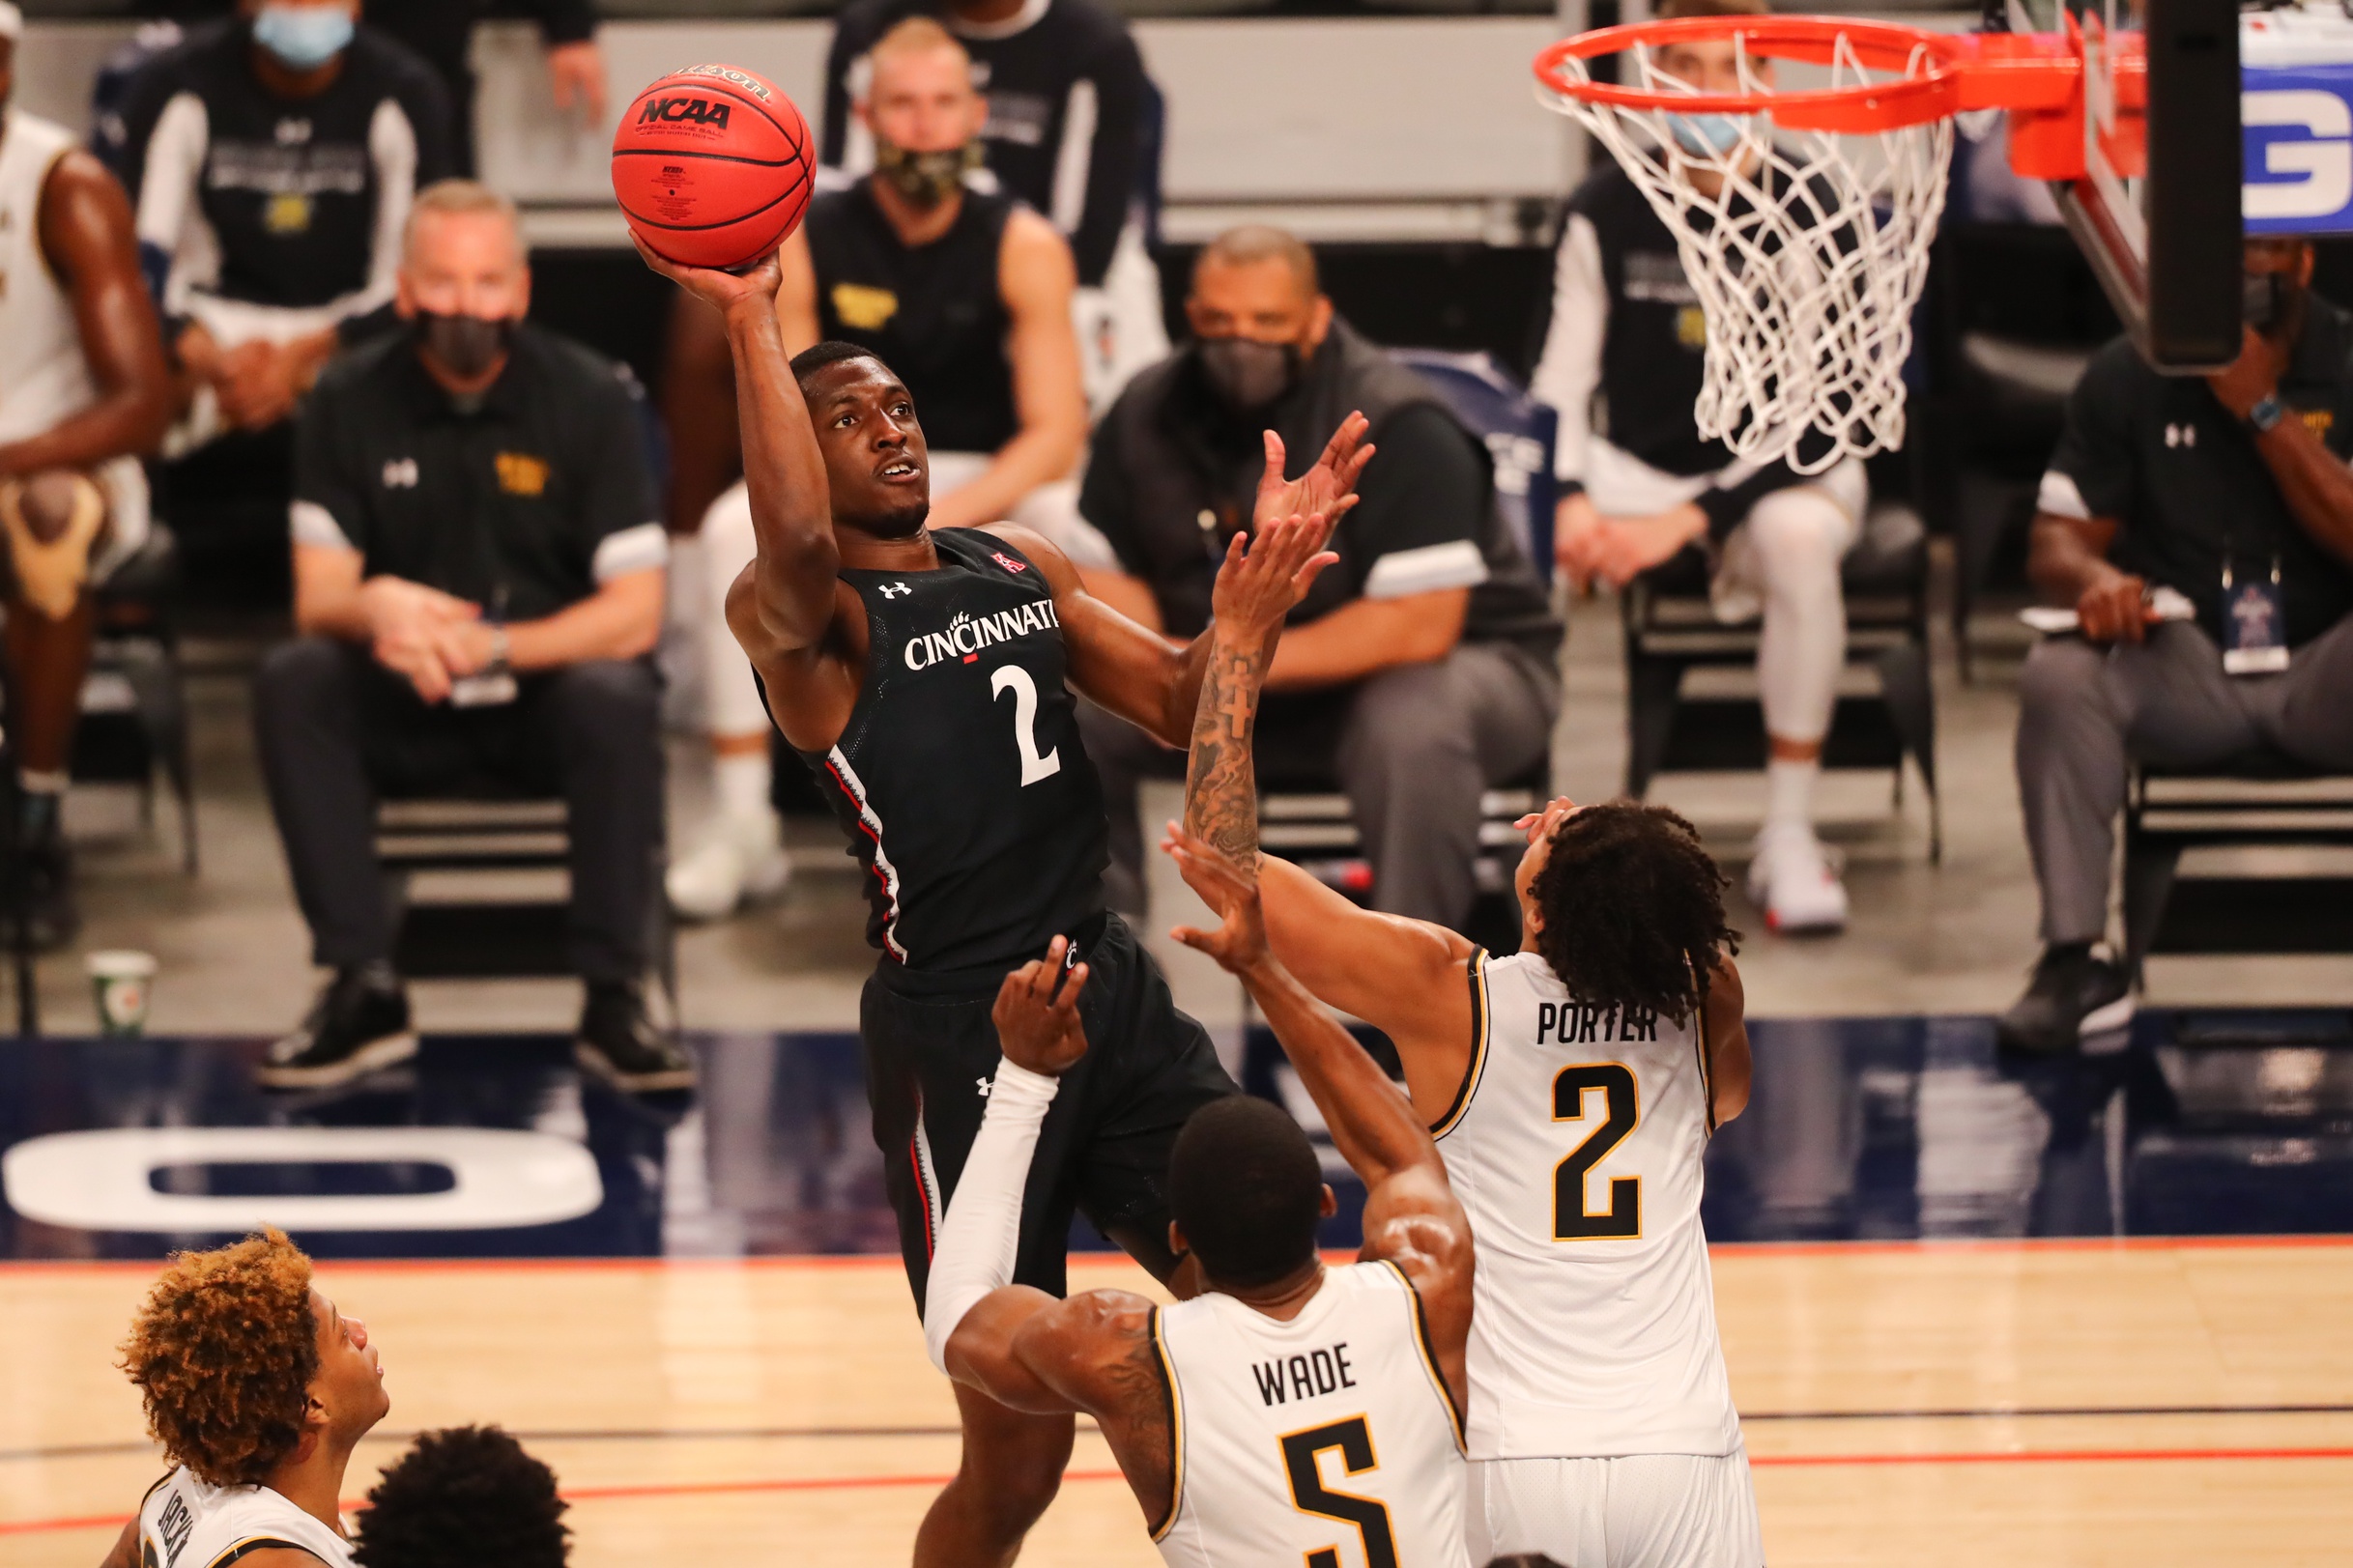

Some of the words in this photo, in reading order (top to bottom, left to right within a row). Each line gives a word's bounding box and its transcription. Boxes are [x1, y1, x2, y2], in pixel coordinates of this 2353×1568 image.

[637, 98, 732, 130] NCAA
[904, 598, 1060, 671] CINCINNATI
[990, 665, 1061, 787] 2
[1537, 1002, 1658, 1045] PORTER
[1551, 1061, 1643, 1242] 2
[1251, 1341, 1357, 1407] WADE
[1275, 1411, 1401, 1568] 5
